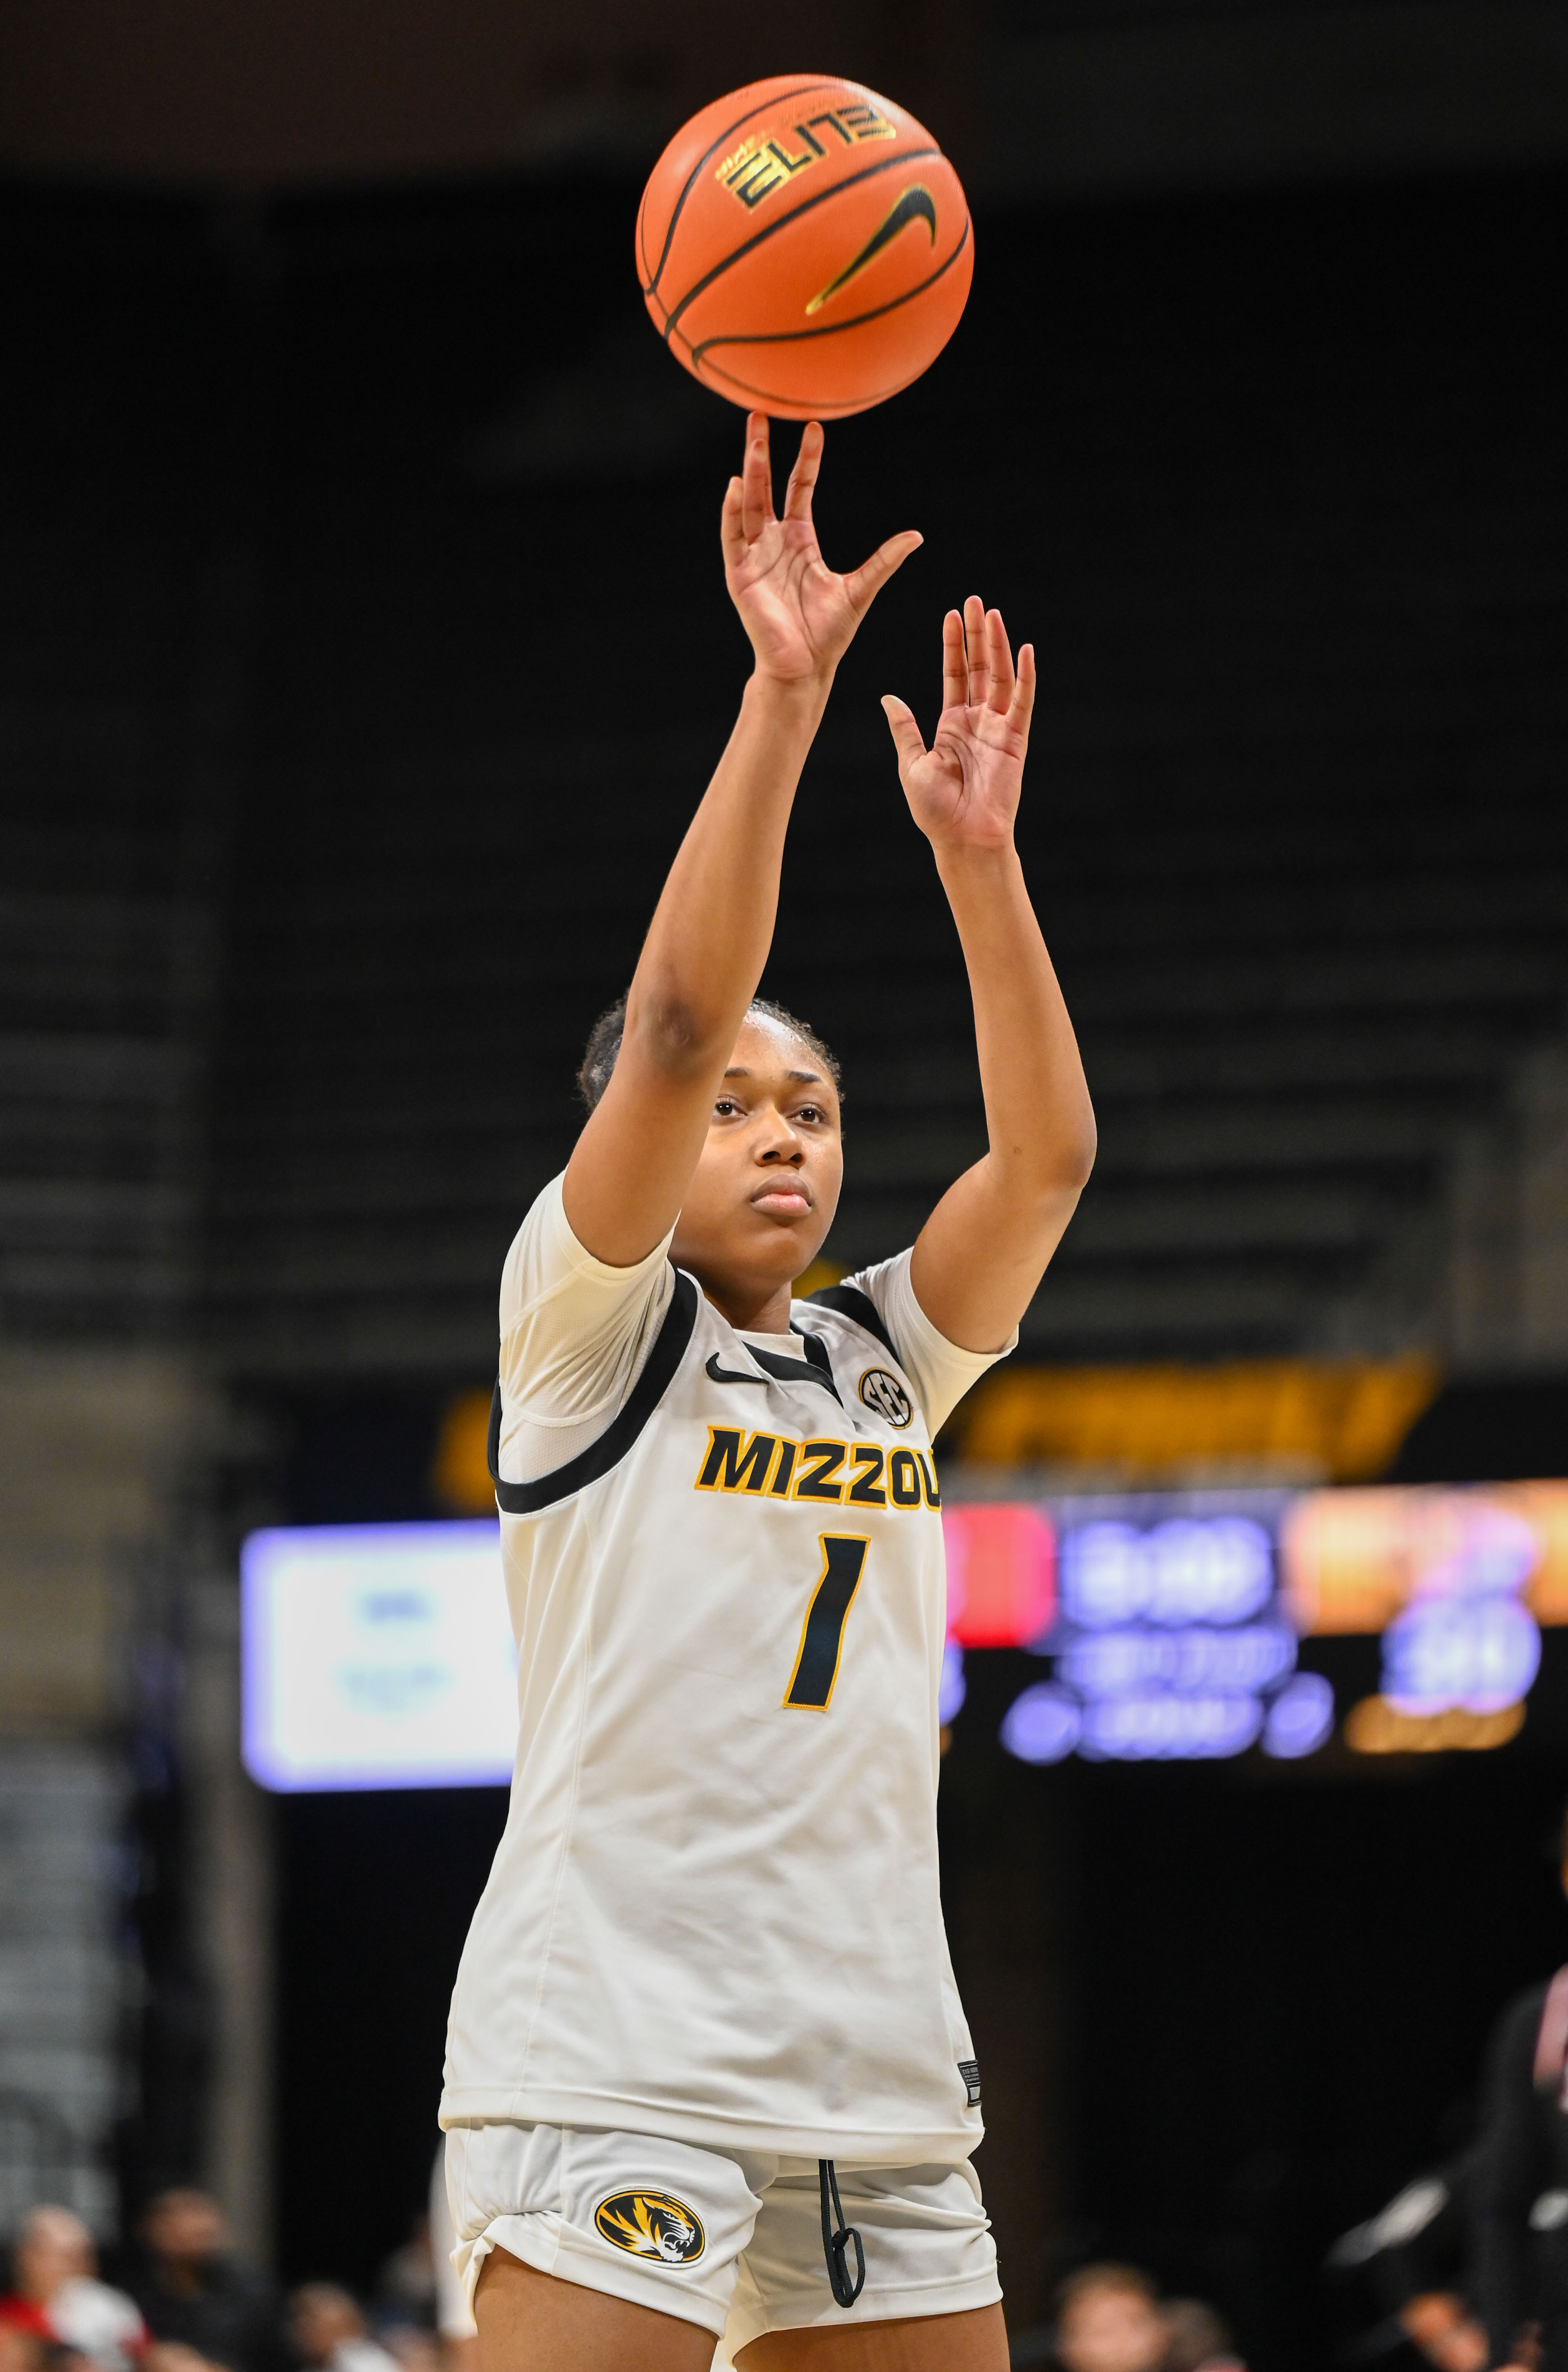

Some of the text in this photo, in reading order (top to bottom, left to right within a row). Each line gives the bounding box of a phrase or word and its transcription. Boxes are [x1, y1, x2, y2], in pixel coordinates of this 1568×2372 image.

[723, 103, 897, 212] ELITE
[862, 1372, 910, 1426] SEC
[694, 1425, 942, 1512] MIZZOU
[783, 1532, 872, 1710] 1
